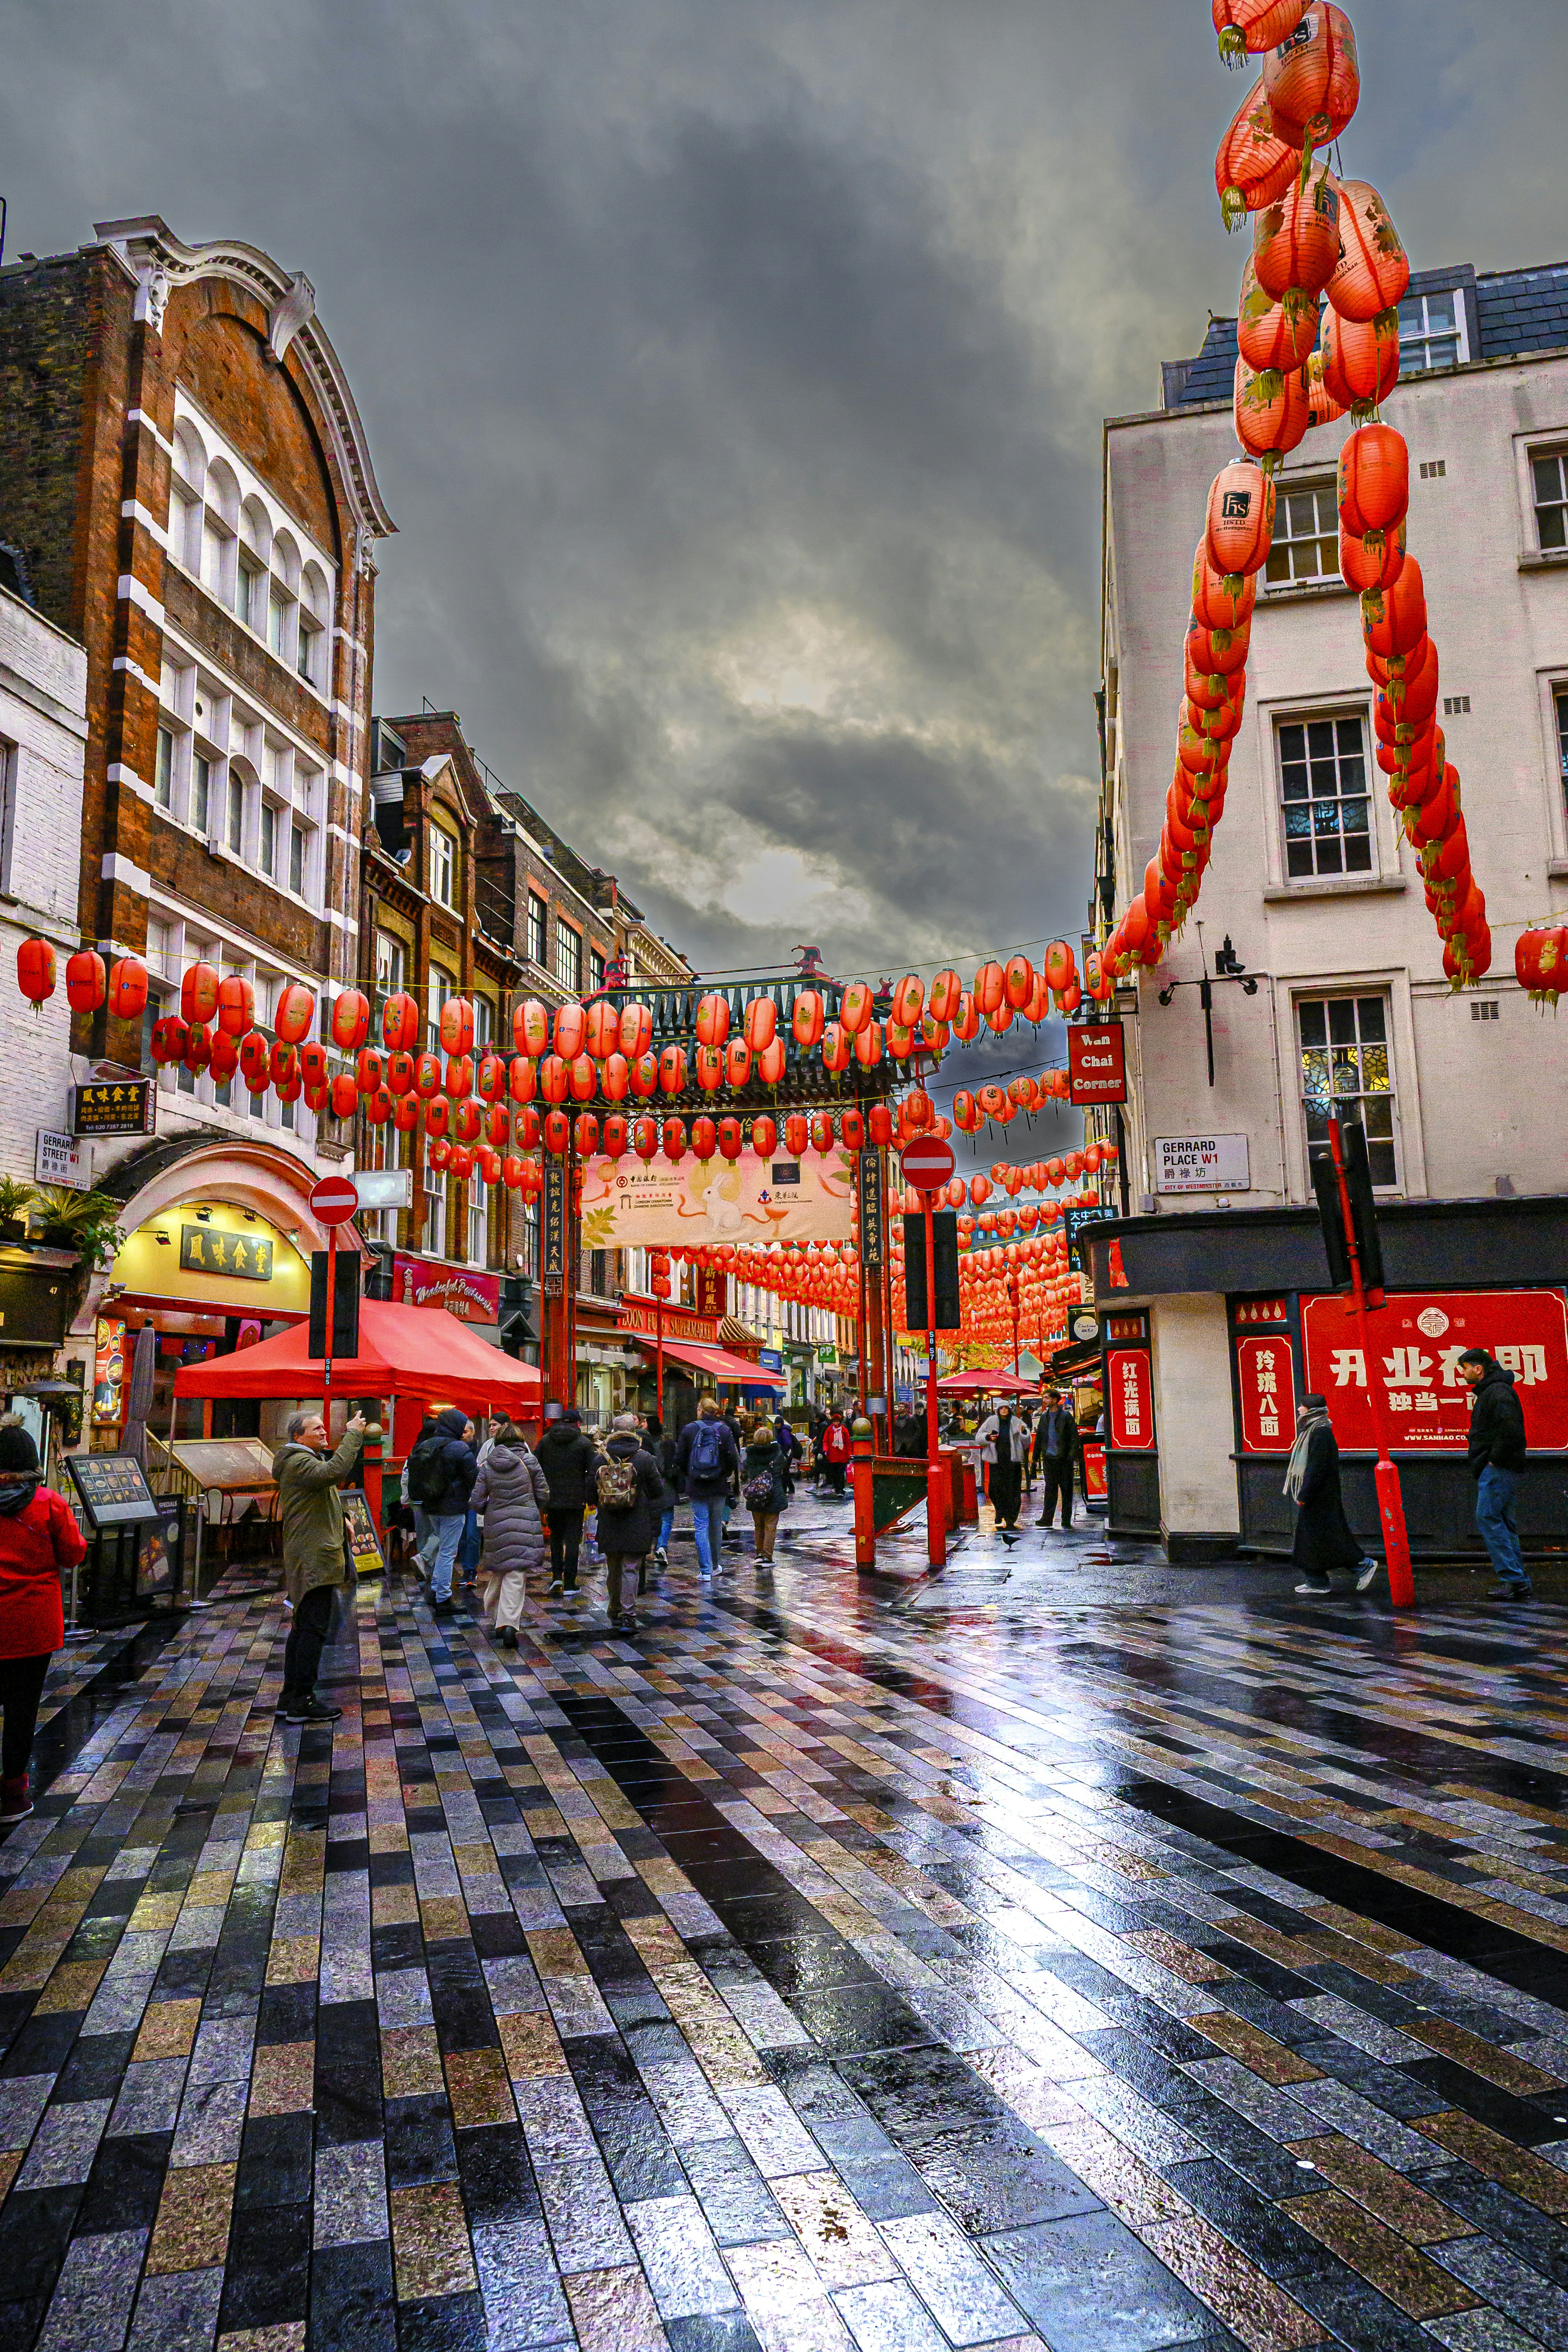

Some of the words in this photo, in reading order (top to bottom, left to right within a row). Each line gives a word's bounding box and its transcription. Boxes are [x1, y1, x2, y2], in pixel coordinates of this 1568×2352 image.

[1082, 1055, 1113, 1068] Chai
[1074, 1078, 1122, 1090] Corner
[44, 1134, 75, 1151] GERRARD
[1163, 1141, 1215, 1153] GERRARD
[43, 1146, 68, 1161] STREET
[70, 1153, 79, 1164] W1
[1164, 1154, 1197, 1166] PLACE
[1201, 1153, 1218, 1164] W1
[622, 1309, 642, 1328] LOON
[647, 1312, 666, 1333] FUG
[670, 1316, 714, 1340] SUPERMARKET
[1122, 1362, 1140, 1435] 红光满面
[1256, 1350, 1279, 1436] 玲珑八面
